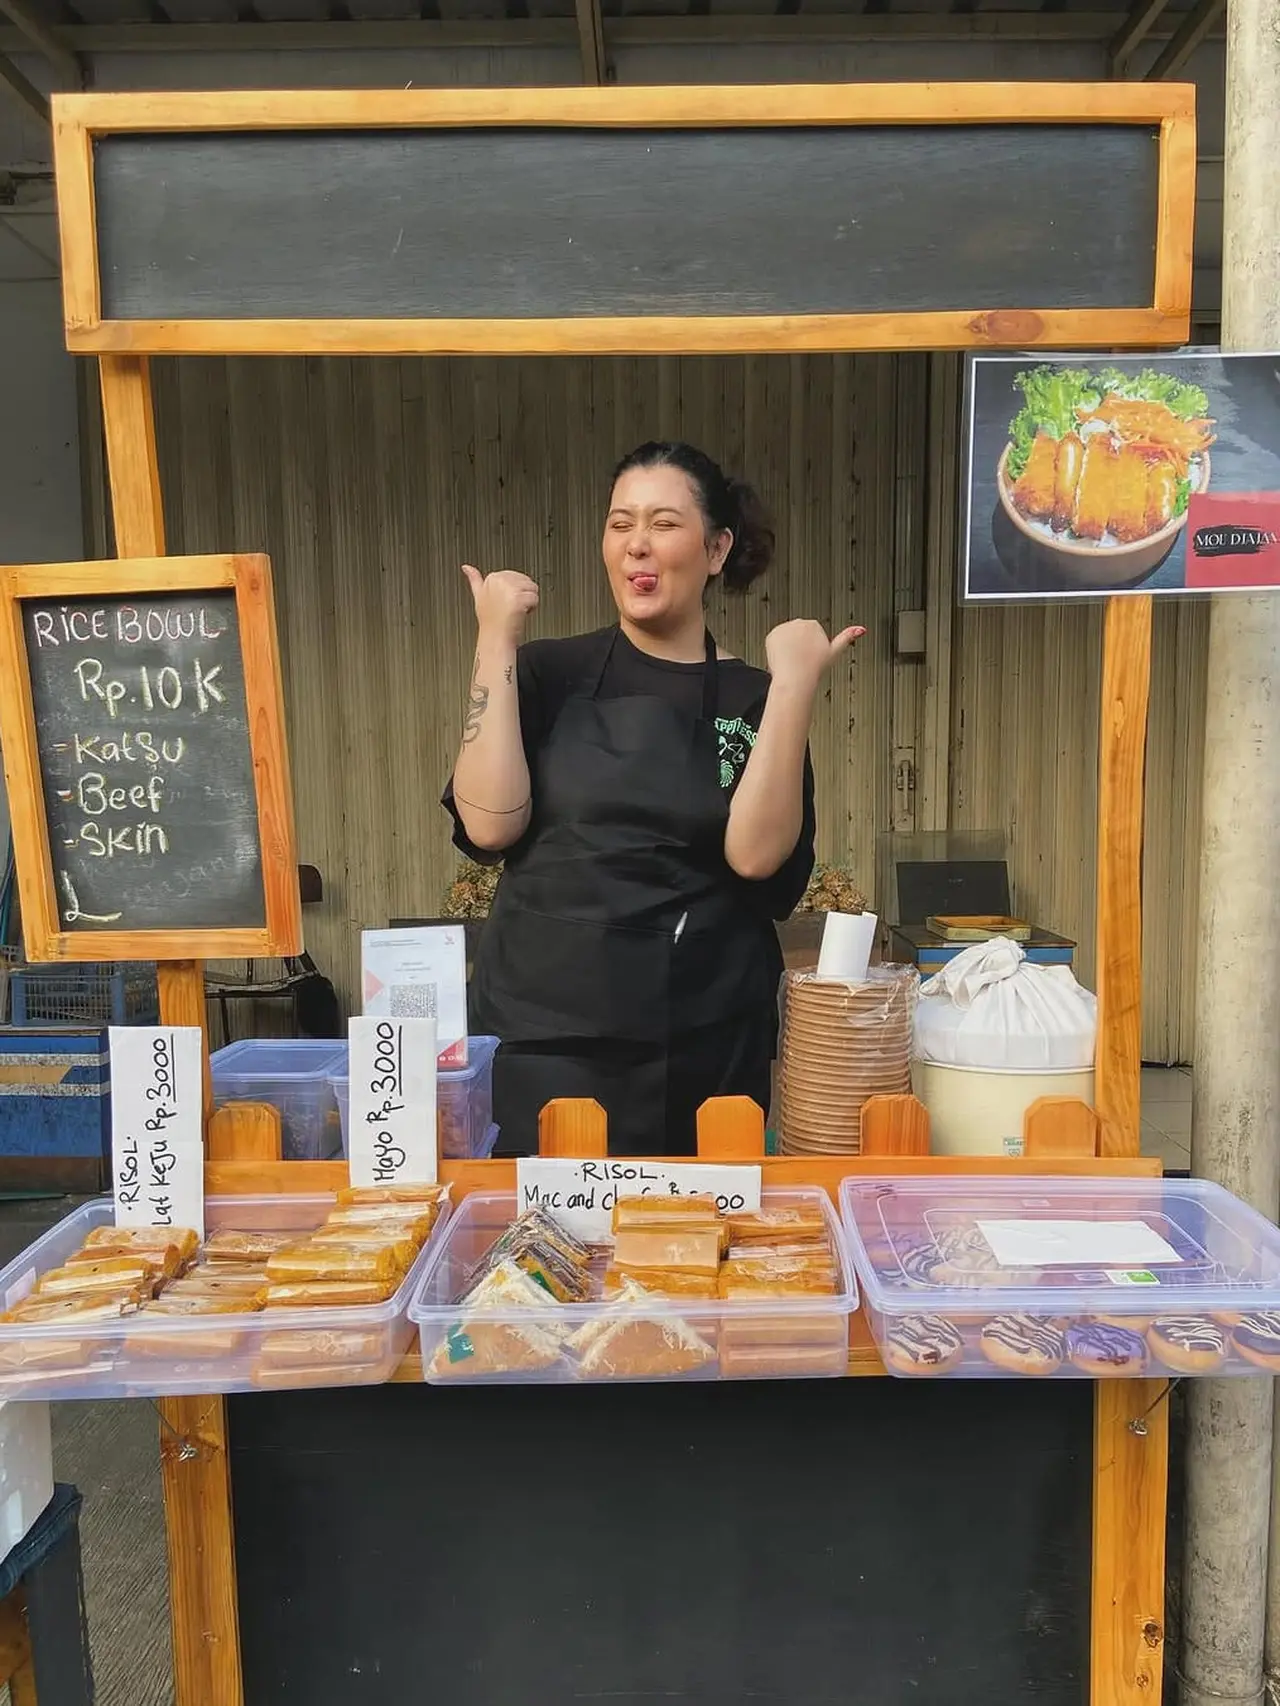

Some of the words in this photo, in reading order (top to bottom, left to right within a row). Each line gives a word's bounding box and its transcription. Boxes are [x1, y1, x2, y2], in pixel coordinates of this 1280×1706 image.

[34, 605, 107, 648] RICE
[117, 605, 222, 643] BOWL
[524, 1184, 562, 1210] Mac
[566, 1186, 596, 1210] and
